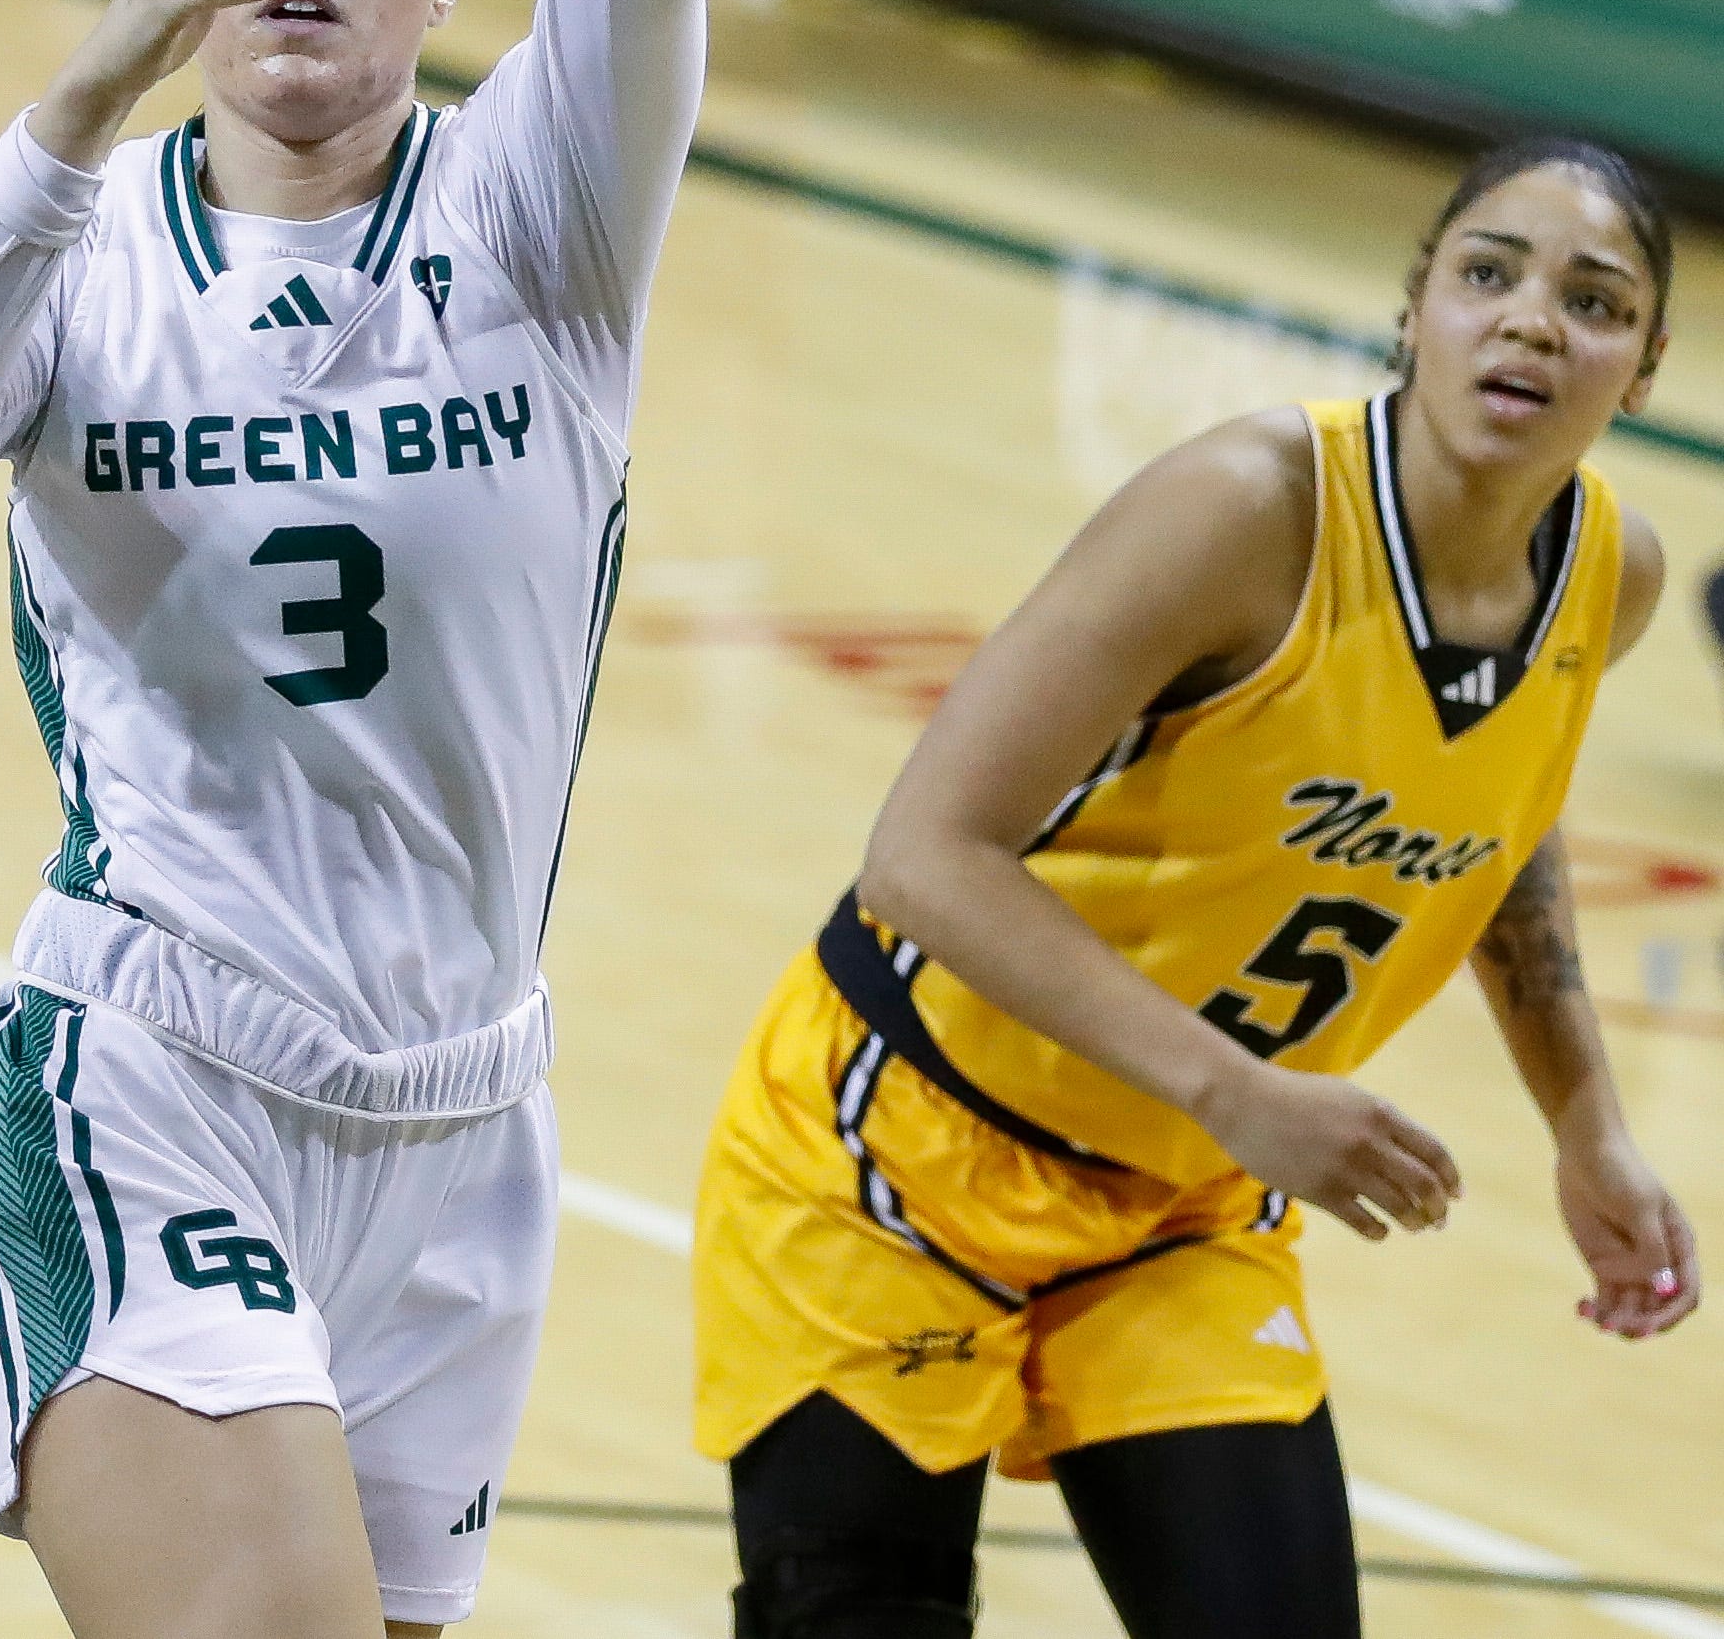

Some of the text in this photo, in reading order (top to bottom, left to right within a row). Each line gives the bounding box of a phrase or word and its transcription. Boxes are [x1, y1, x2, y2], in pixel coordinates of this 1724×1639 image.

[84, 384, 532, 492] GREEN BAY
[249, 523, 389, 707] 3
[1197, 894, 1405, 1062] 5
[158, 1208, 296, 1313] GB
